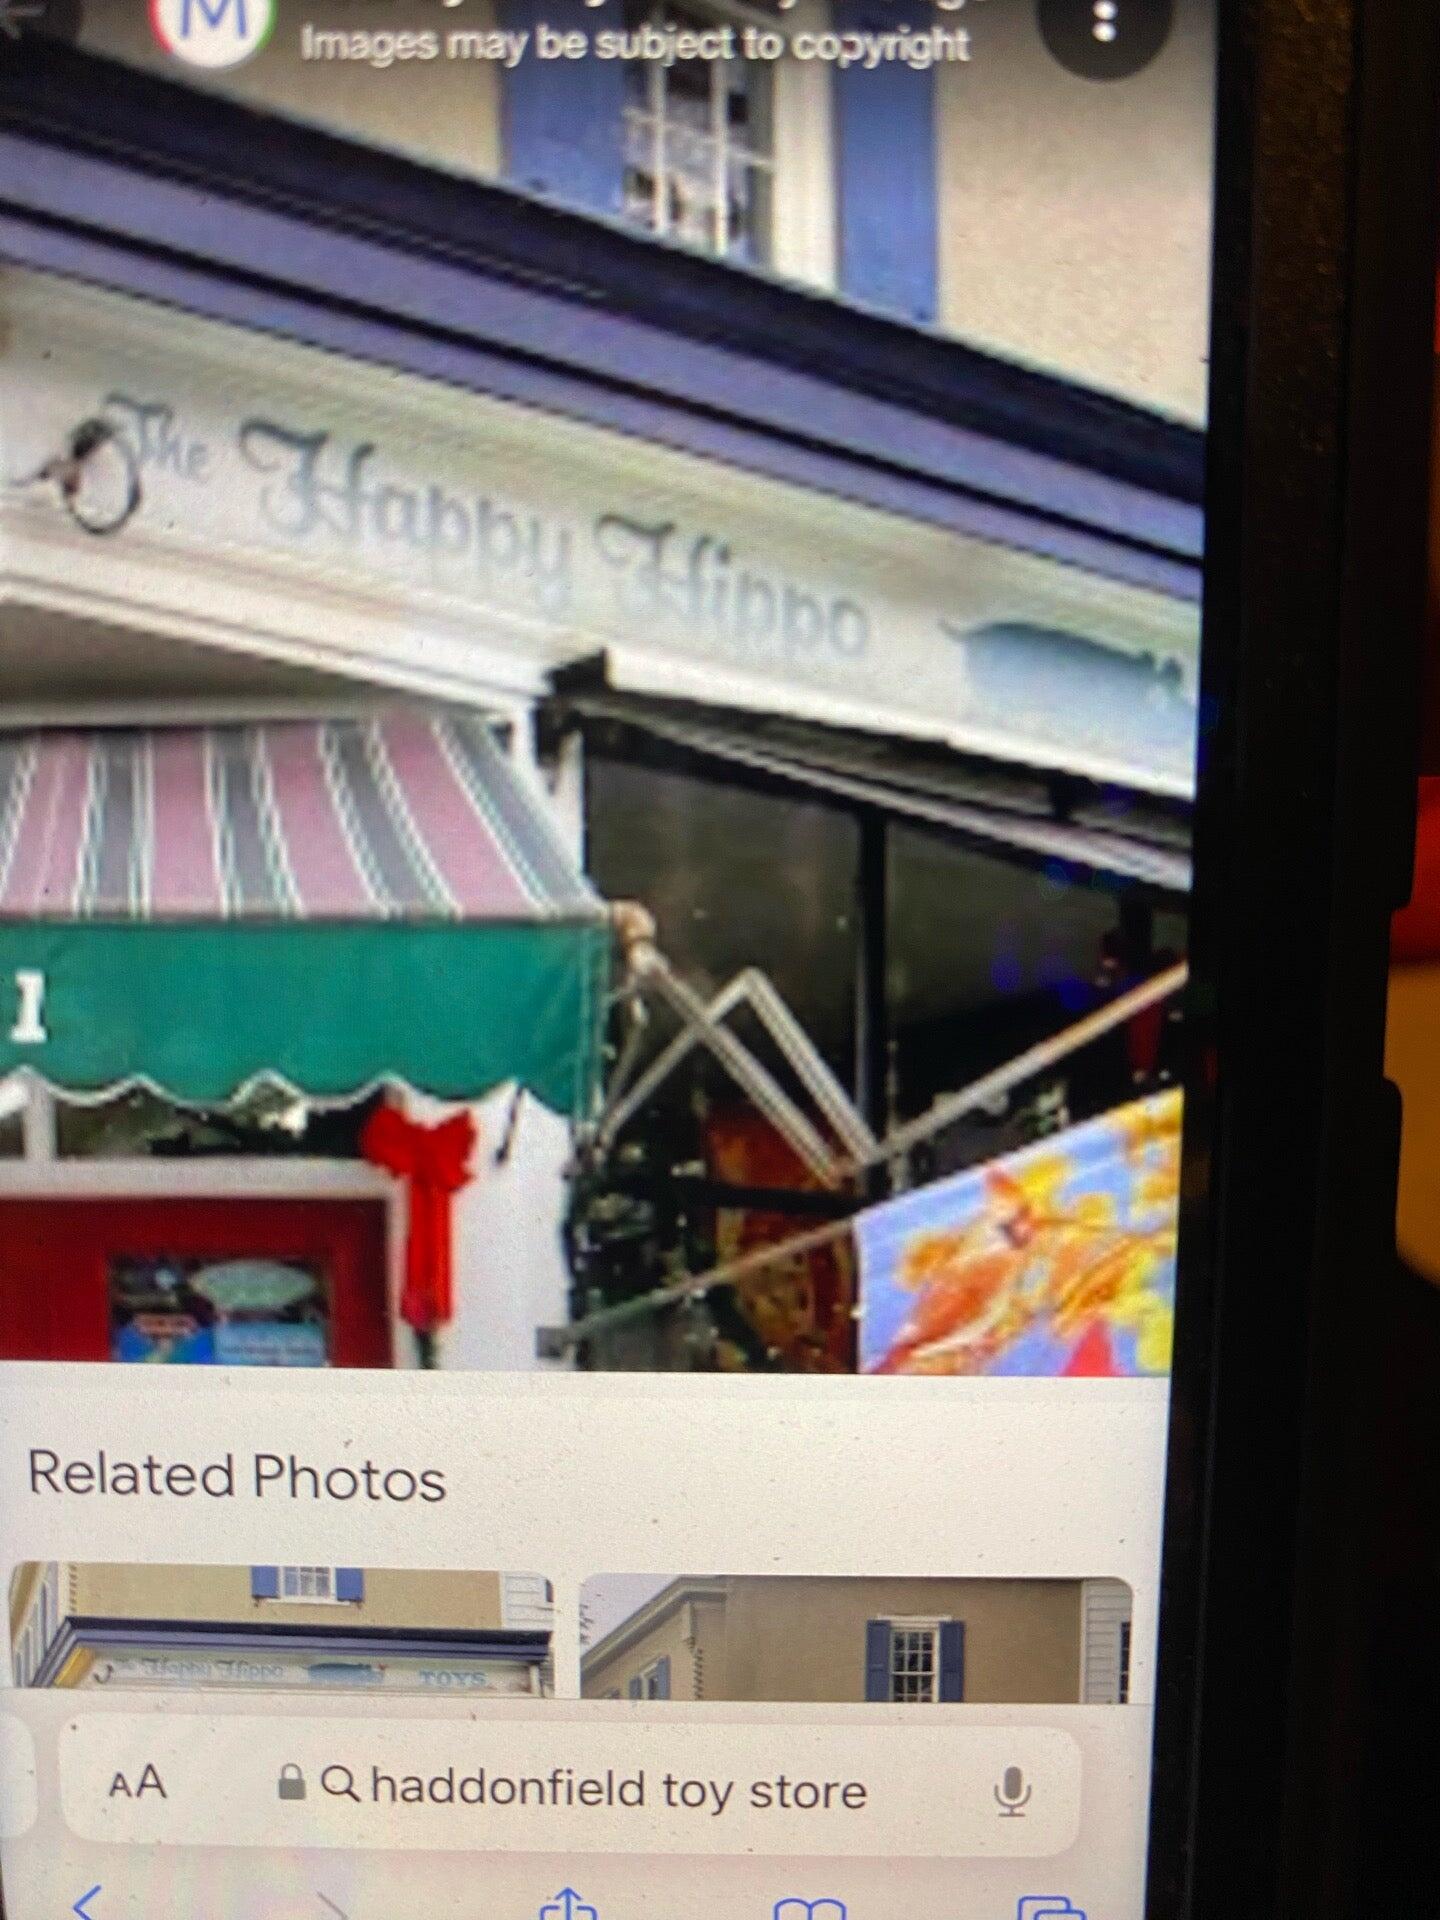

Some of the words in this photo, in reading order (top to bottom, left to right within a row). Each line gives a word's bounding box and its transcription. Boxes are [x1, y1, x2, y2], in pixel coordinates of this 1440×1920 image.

[301, 23, 440, 68] Images
[447, 29, 530, 68] may
[535, 23, 589, 59] be
[595, 23, 735, 67] subject
[742, 26, 785, 60] to
[792, 24, 972, 69] copyright
[104, 391, 210, 482] The
[239, 416, 573, 610] Happy
[597, 513, 870, 662] Hippo
[28, 1448, 235, 1497] Related
[253, 1453, 447, 1503] Photos
[418, 1668, 488, 1688] TOYS
[371, 1765, 645, 1807] haddonfield
[661, 1772, 735, 1817] toy
[749, 1774, 868, 1810] store
